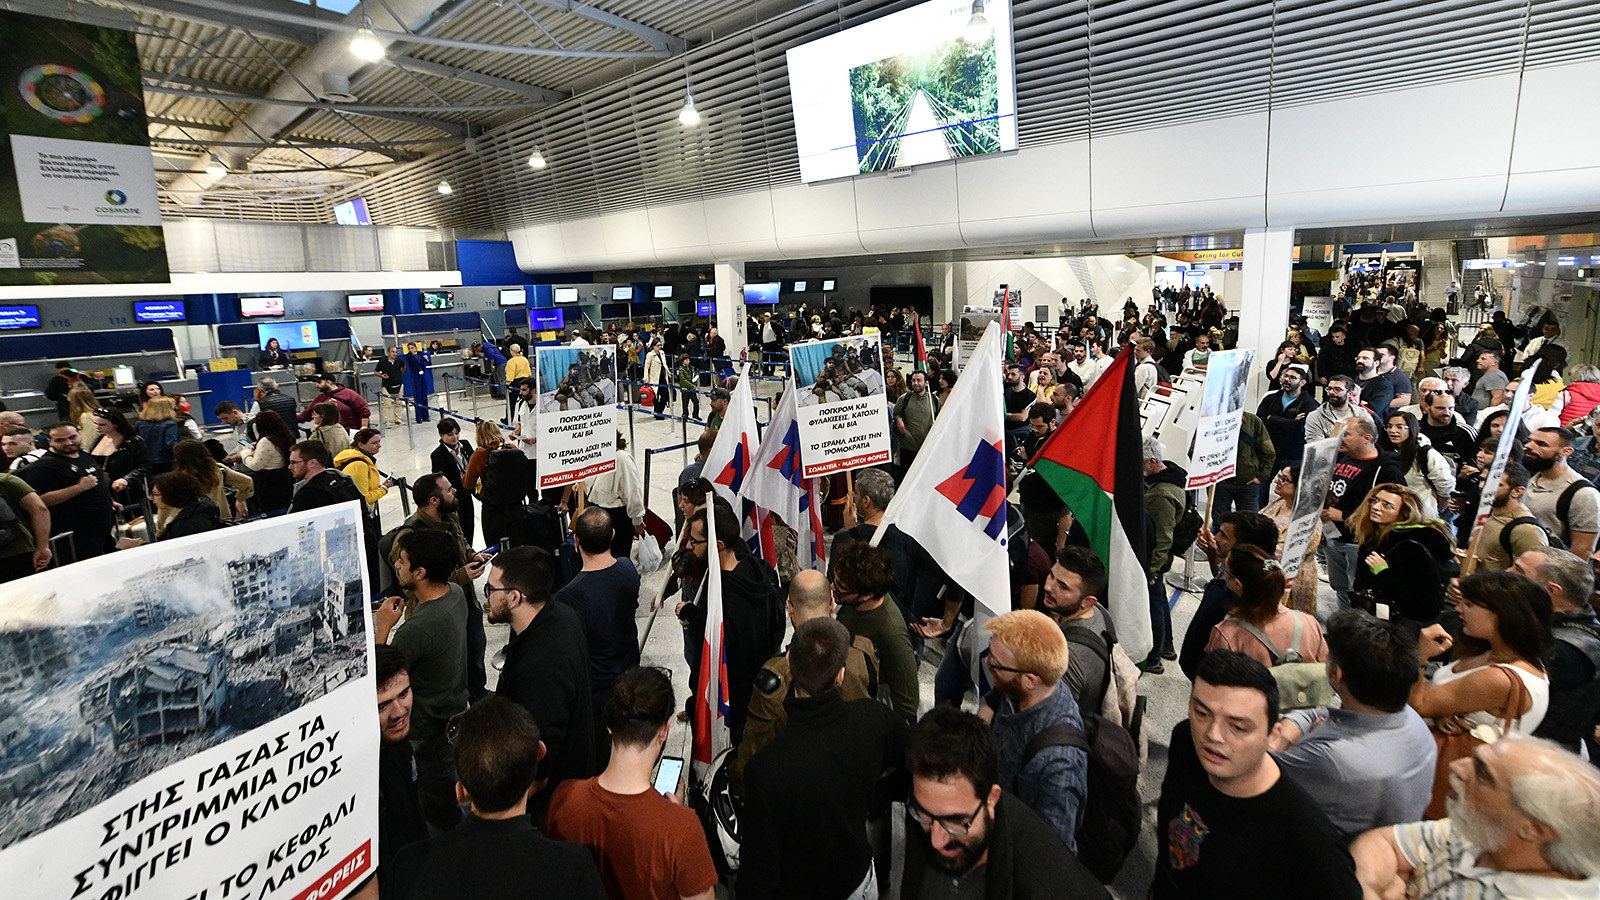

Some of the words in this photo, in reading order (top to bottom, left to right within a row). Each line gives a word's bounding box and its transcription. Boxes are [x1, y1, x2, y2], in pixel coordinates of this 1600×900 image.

[819, 406, 854, 416] ΠΟΓΚΡΟΜ
[852, 409, 879, 418] ΚΑΤΟΧΗ
[560, 414, 592, 423] ΠΟΓΚΡΟΜ
[590, 418, 611, 427] ΚΑΤΟΧΗ
[822, 439, 847, 448] ΙΣΡΑΗΛ
[824, 442, 870, 455] ΤΡΟΜΟΚΡΑΤΙΑ
[559, 449, 584, 458] ΙΣΡΑΗΛ
[808, 464, 837, 473] ΣΩΜΑΤΕΙΑ
[842, 458, 867, 467] ΜΑΣΙΚΟΙ
[867, 453, 888, 462] ΦΟΡΕΙΣ
[544, 474, 574, 484] ΣΩΜΑΤΕΙΑ
[99, 780, 186, 848] ΣΤΗΣ
[196, 731, 291, 792] ΓΑΖΑΣ
[298, 714, 326, 742] ΤΑ
[70, 767, 278, 900] ΣΥΝΤΡΙΜΜΙΑ
[287, 730, 341, 776] ΠΟΥ
[98, 837, 192, 900] ΦΙΓΓΕΙ
[205, 821, 230, 846] Ο
[240, 755, 344, 830] ΚΛΟΙΟΣ
[220, 863, 258, 898] ΤΟ
[266, 795, 356, 870] ΚΕΦΑΛΙ
